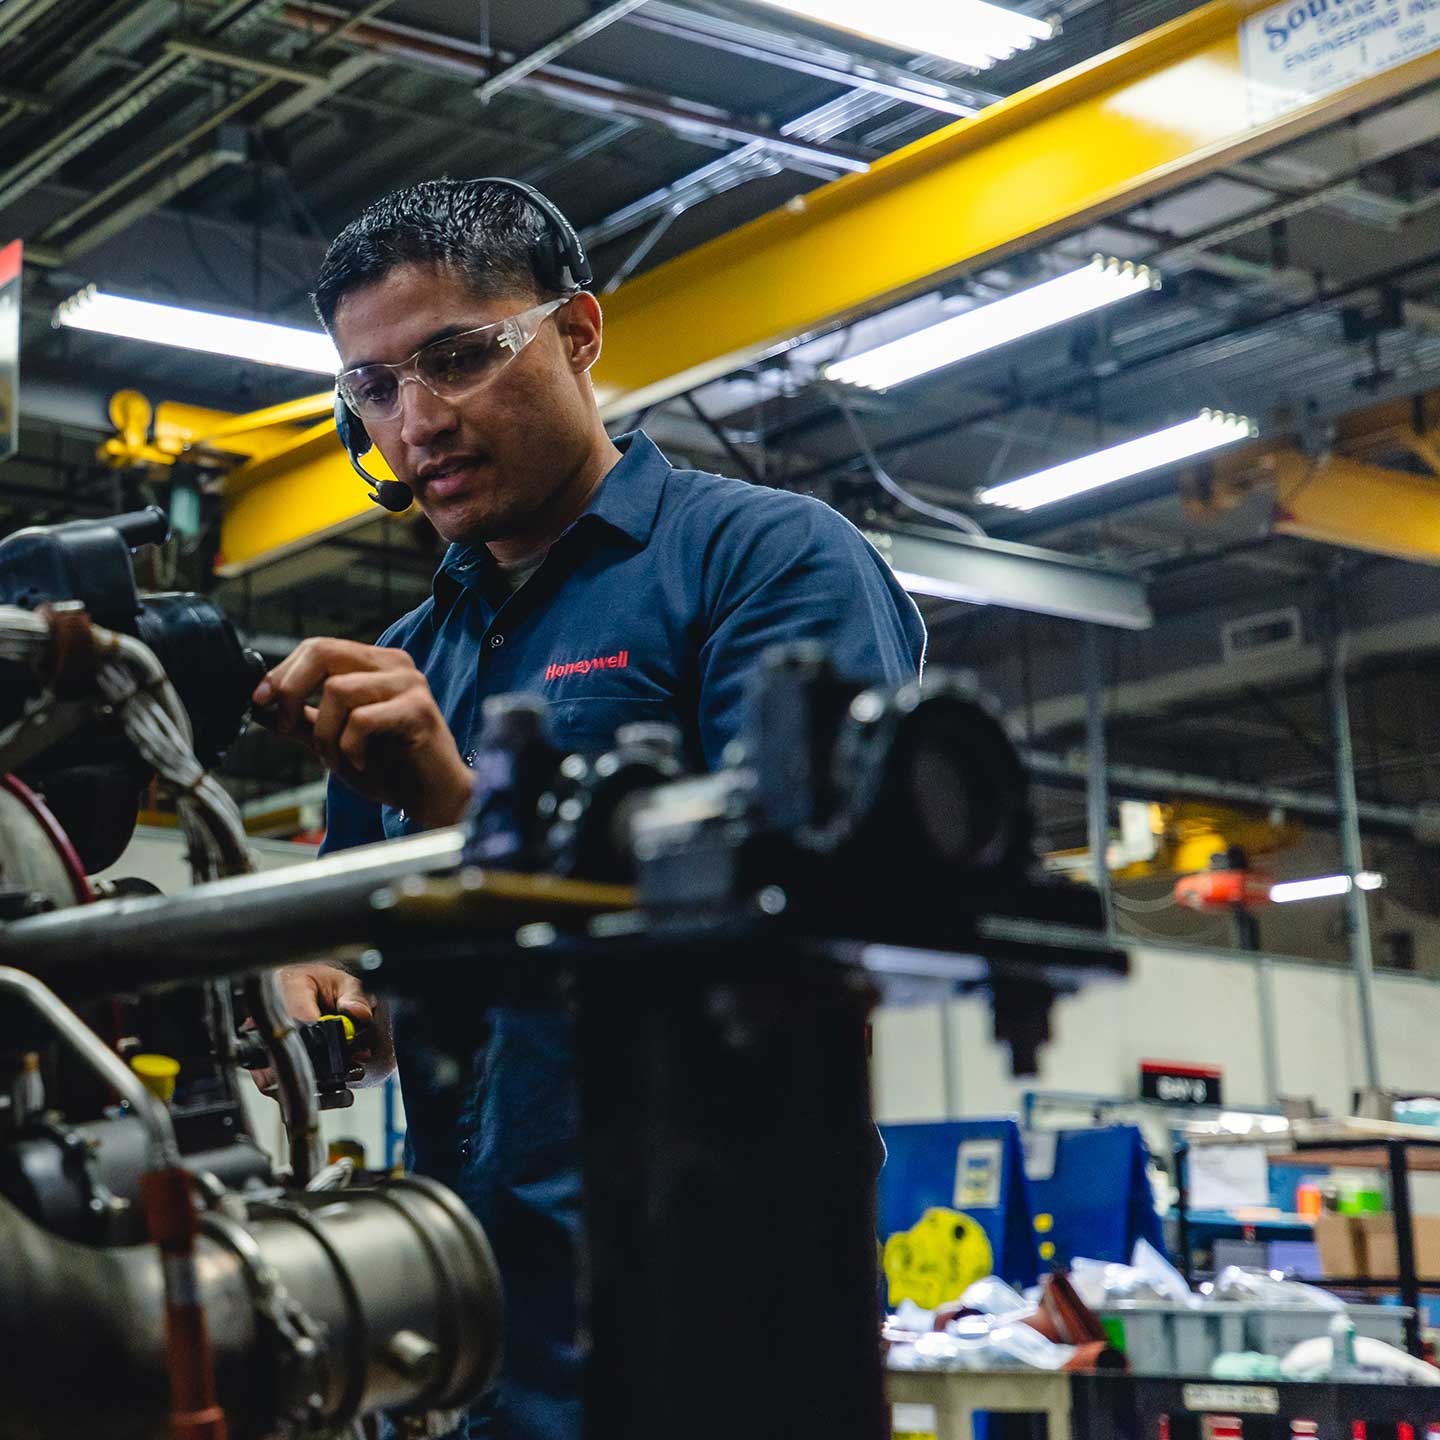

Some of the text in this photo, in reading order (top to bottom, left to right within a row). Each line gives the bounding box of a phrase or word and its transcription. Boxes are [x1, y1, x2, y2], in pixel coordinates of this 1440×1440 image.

[1263, 0, 1341, 52] Sou
[1282, 8, 1402, 71] ENGINEERING
[545, 650, 628, 681] Honeywell
